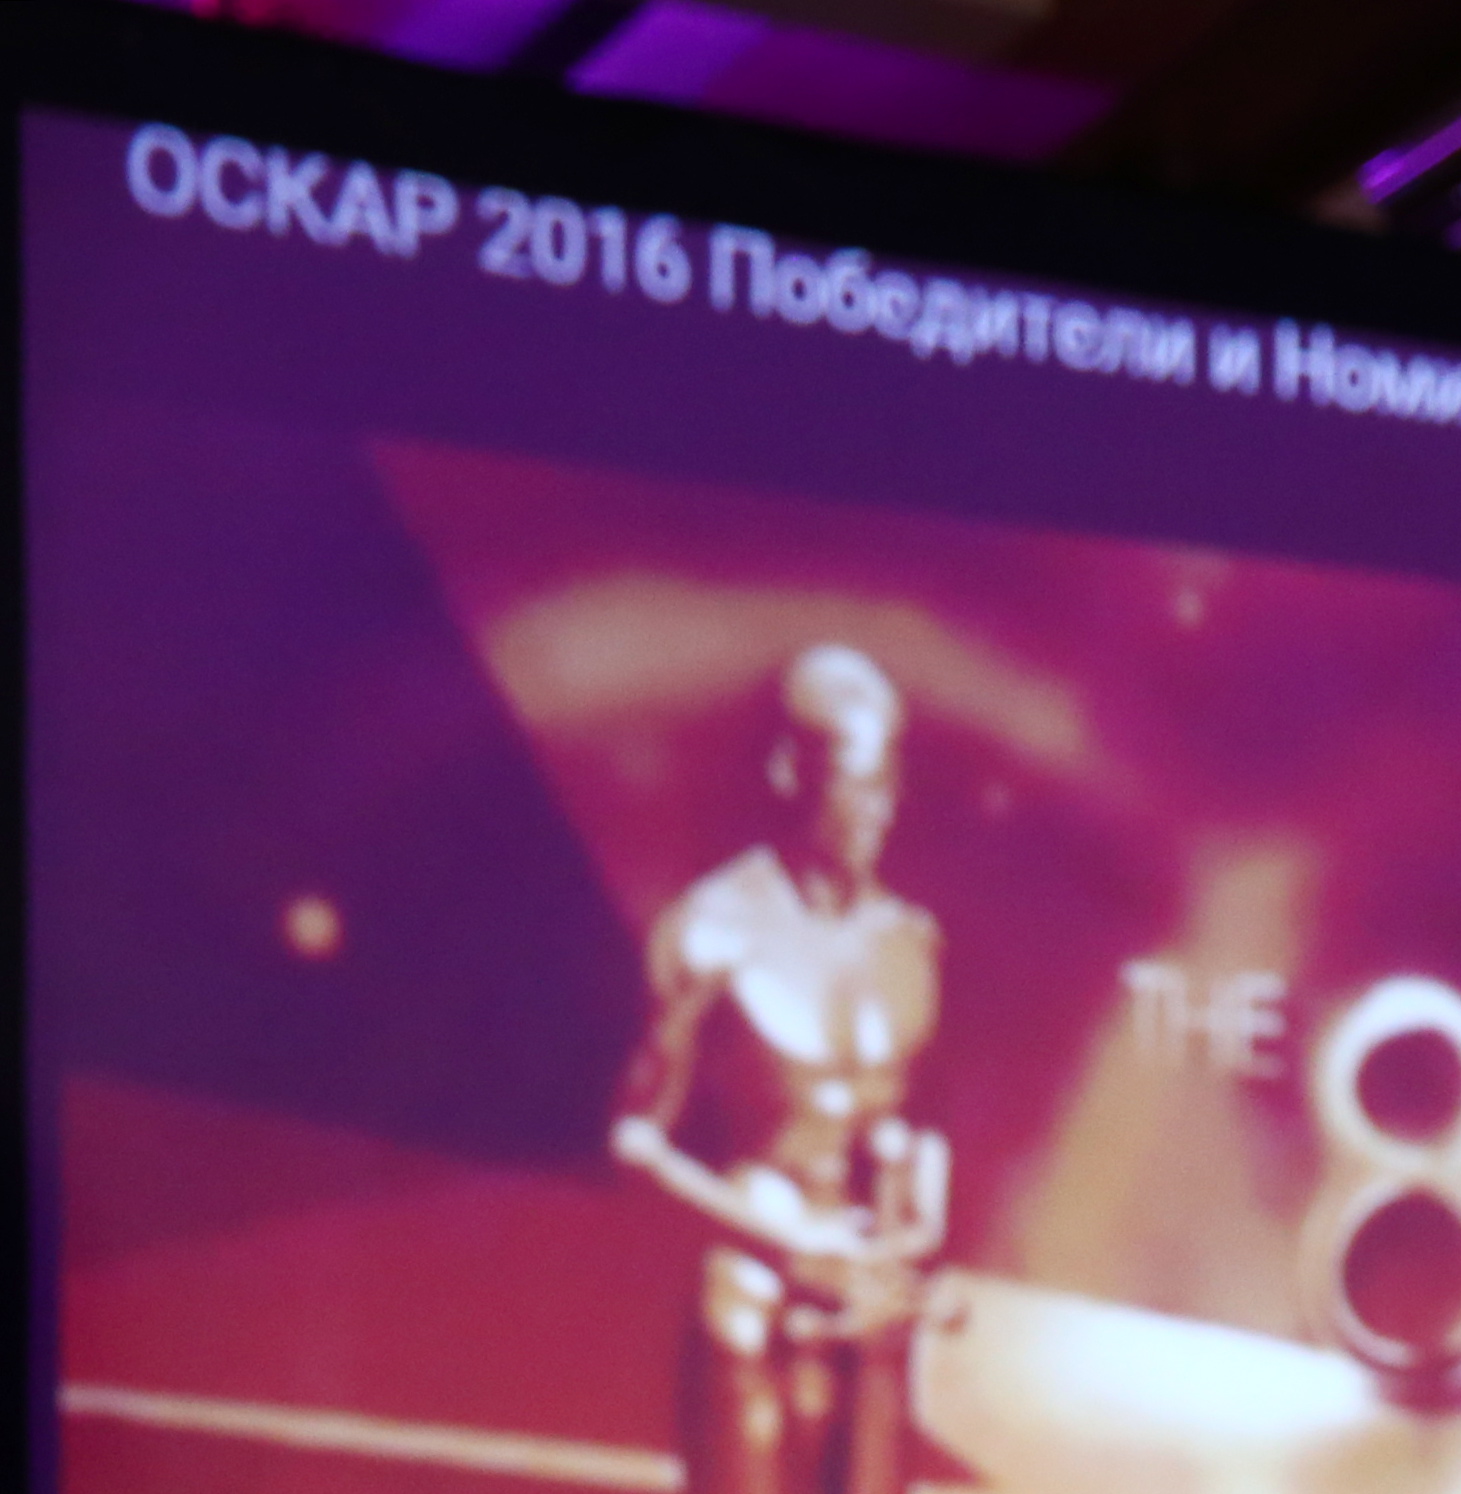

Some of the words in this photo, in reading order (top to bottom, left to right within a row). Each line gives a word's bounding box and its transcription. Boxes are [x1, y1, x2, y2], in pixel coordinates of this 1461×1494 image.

[126, 121, 460, 260] ОСКАР
[477, 187, 692, 304] 2016
[708, 223, 1197, 387] Победители
[1208, 323, 1262, 396] и
[1118, 962, 1288, 1078] THE
